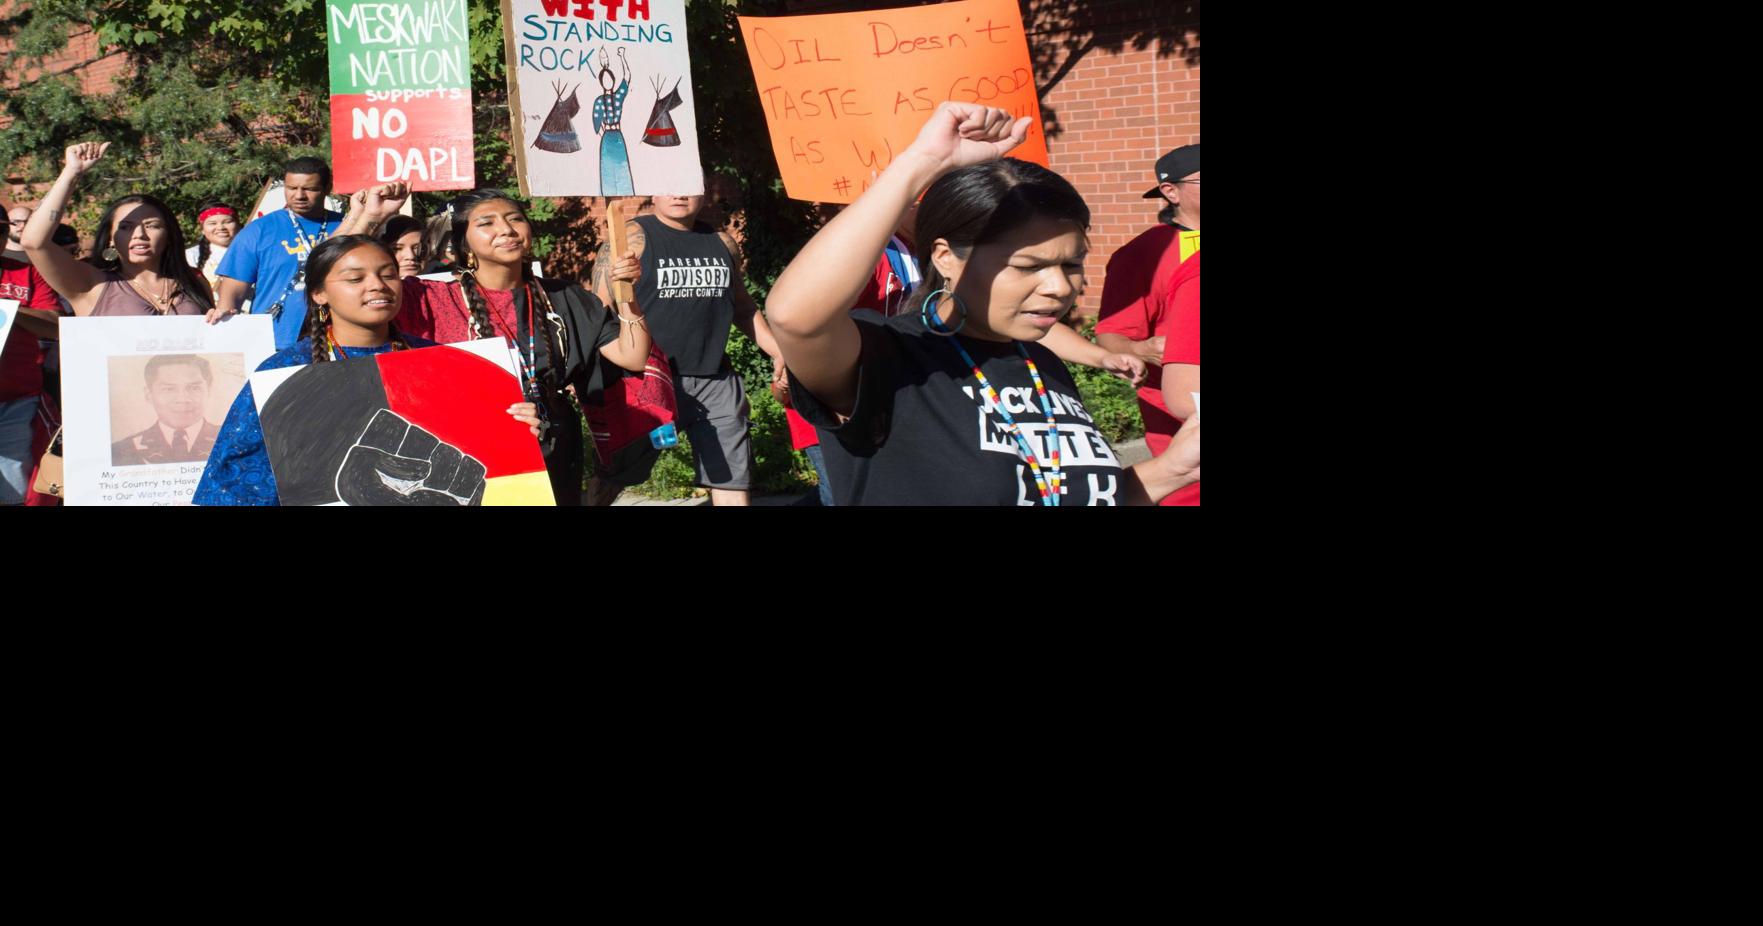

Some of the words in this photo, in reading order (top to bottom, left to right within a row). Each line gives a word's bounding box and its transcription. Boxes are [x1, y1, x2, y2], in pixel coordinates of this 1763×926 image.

[330, 0, 468, 45] MESKWAKI
[523, 14, 672, 43] STANDING
[753, 27, 840, 70] OIL
[868, 17, 1010, 57] Doesn't
[350, 46, 464, 87] NATION
[520, 44, 597, 79] ROCK
[365, 83, 462, 103] supports
[763, 86, 872, 120] TASTE
[894, 87, 934, 114] AS
[949, 68, 1030, 104] GOOD
[352, 107, 408, 140] NO
[376, 146, 472, 182] DAPL
[790, 136, 824, 165] AS
[659, 257, 727, 267] PARENTAL
[661, 268, 729, 287] ADVISORY
[659, 289, 694, 298] EXPLICIT
[696, 288, 723, 298] CONTEN
[99, 482, 119, 490] This
[121, 480, 159, 489] Country
[174, 478, 197, 486] Have
[101, 471, 116, 480] My
[115, 492, 133, 500] Our
